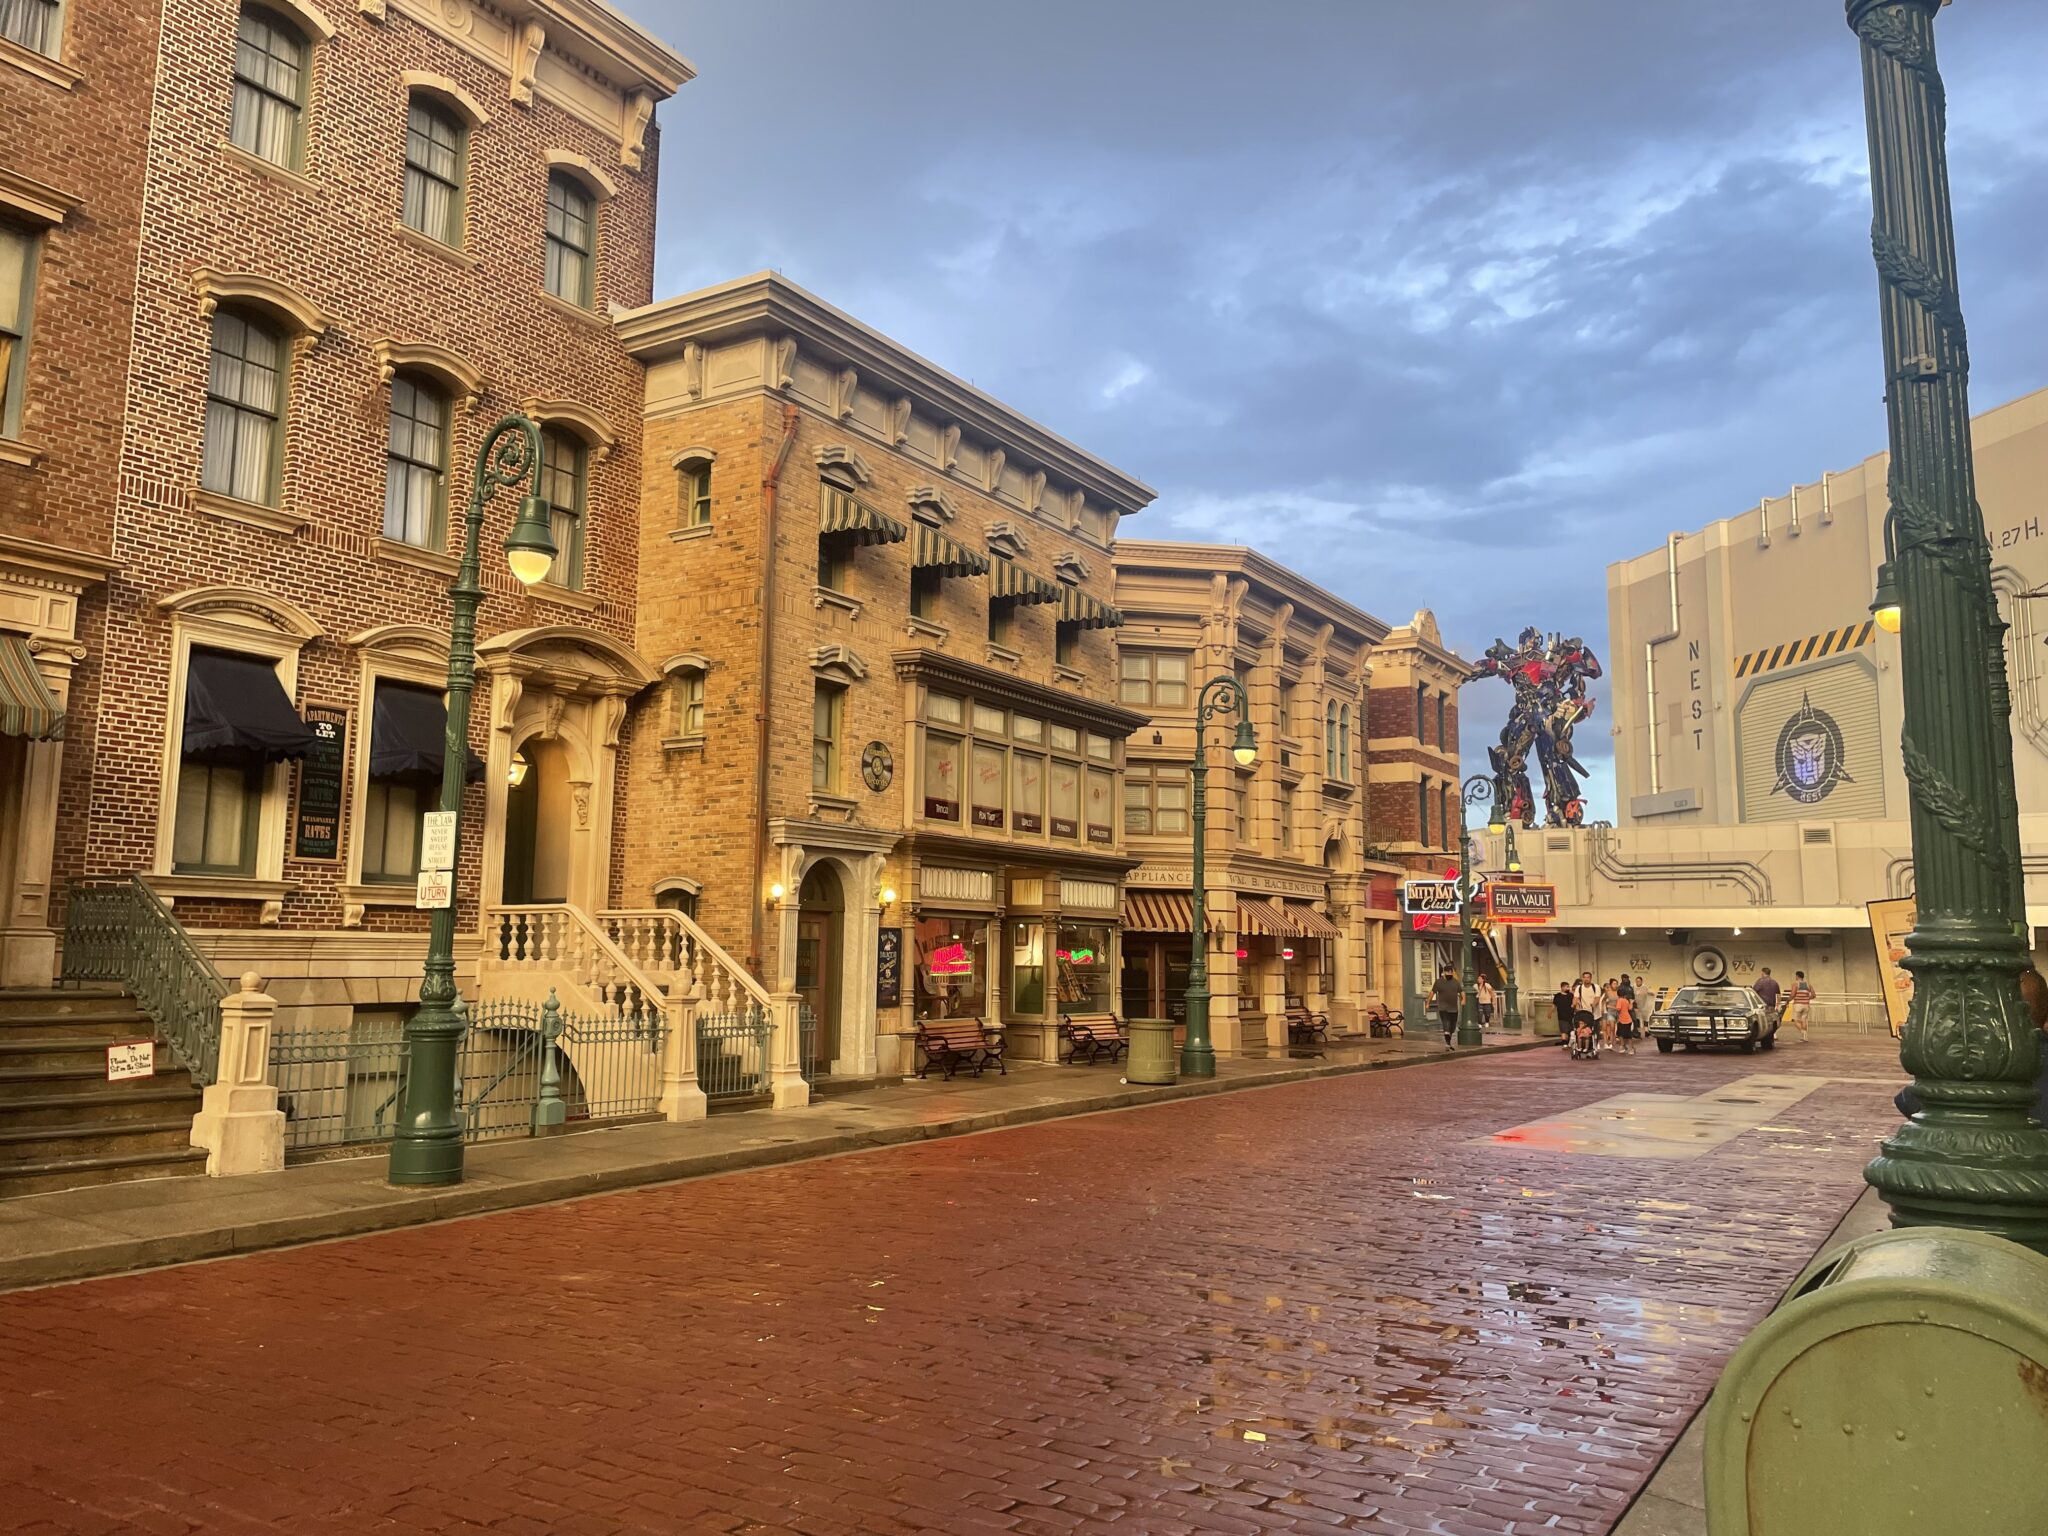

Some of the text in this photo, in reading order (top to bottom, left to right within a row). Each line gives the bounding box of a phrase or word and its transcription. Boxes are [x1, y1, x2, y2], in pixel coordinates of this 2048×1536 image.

[1689, 640, 1703, 751] NEST
[307, 710, 346, 726] APARTMENTS
[315, 729, 336, 738] LET
[319, 722, 333, 731] TO
[427, 815, 453, 826] THE LAW
[304, 824, 331, 839] RATES
[428, 874, 443, 886] NO
[1126, 872, 1191, 883] APPLIANCE
[1251, 877, 1260, 887] B.
[1264, 879, 1324, 895] HACKENBURG
[1407, 883, 1454, 900] KITTY KAT
[420, 887, 447, 900] U TURN
[1496, 893, 1551, 907] FILM VAULT
[1421, 896, 1454, 911] Club
